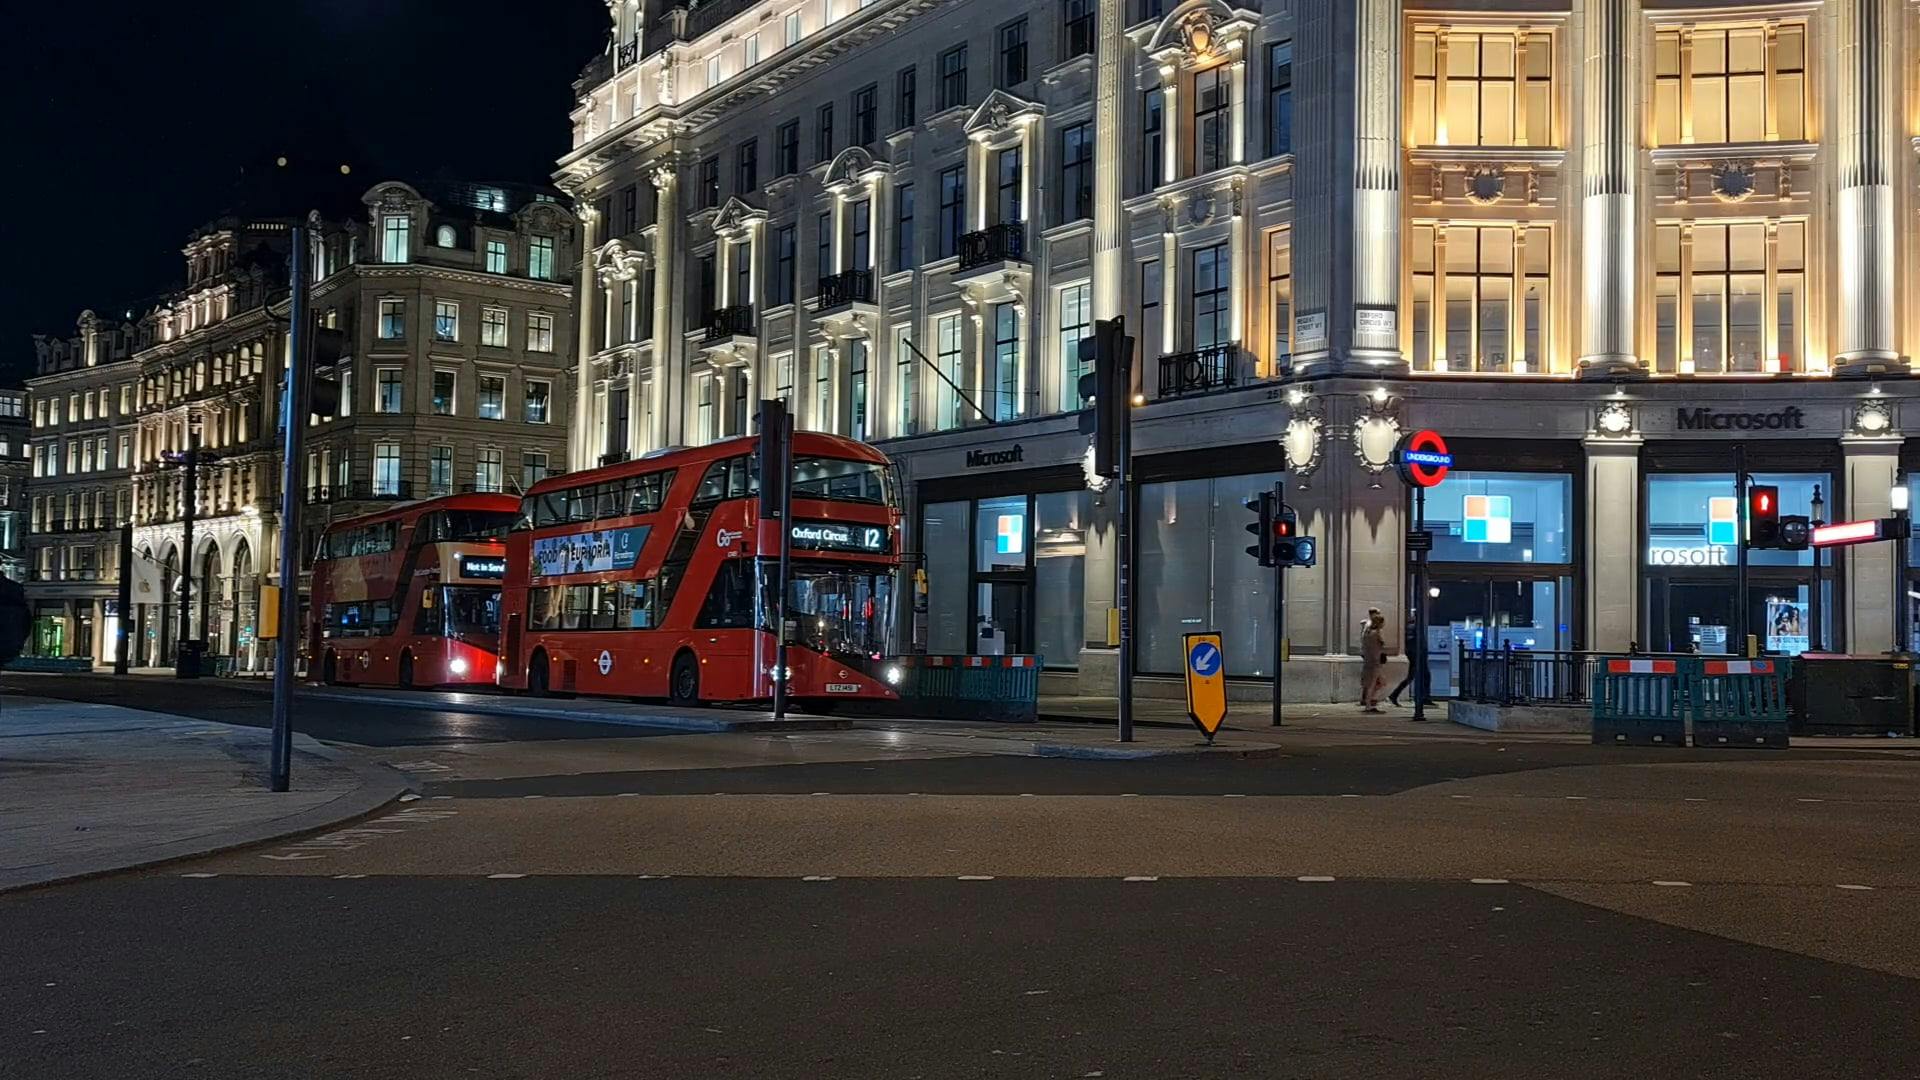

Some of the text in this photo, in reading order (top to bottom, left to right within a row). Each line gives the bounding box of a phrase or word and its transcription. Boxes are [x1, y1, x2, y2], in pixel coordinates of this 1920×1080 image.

[1360, 311, 1384, 319] OXFORD
[1360, 319, 1381, 327] CIRCUS
[1677, 406, 1804, 430] Microsoft
[966, 443, 1023, 468] Microsoft
[1406, 452, 1451, 464] UNDERGROUND
[791, 527, 848, 542] Oxford Circus
[864, 528, 880, 548] 12
[570, 541, 611, 562] EUPHORIA
[466, 561, 479, 571] Not
